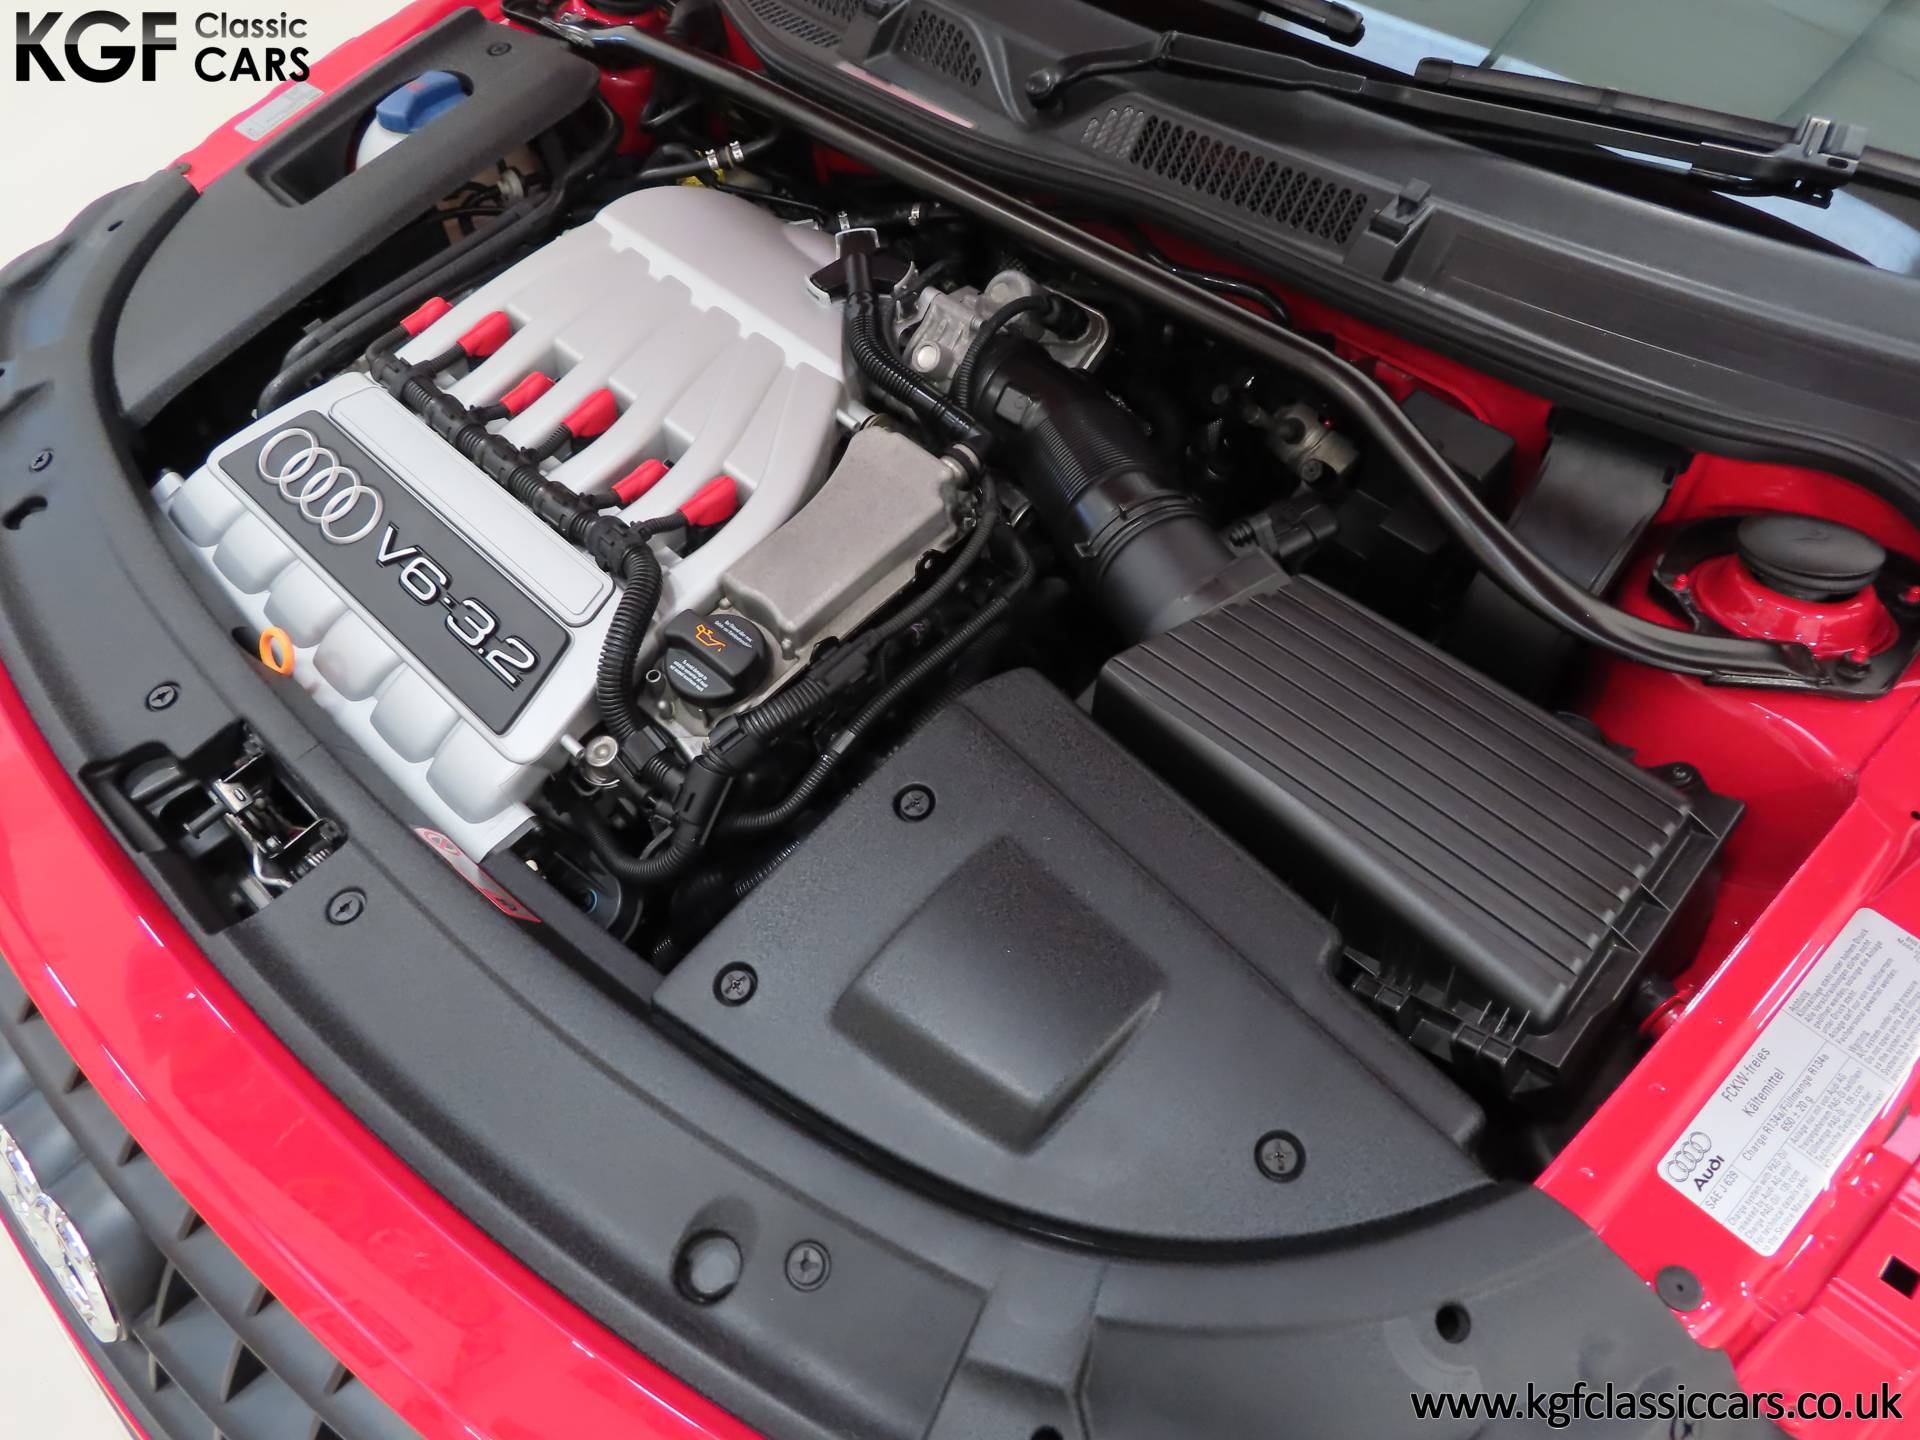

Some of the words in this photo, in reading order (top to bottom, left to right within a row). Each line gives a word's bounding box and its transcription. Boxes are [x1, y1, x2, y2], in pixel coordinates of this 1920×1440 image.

[1722, 1050, 1770, 1102] FCKW-freies
[1742, 1068, 1785, 1117] Kältemittel
[1742, 1133, 1769, 1162] Charge
[1807, 1052, 1830, 1076] R134a
[1780, 1117, 1795, 1131] 650
[1796, 1101, 1808, 1111] 20
[1694, 1155, 1724, 1191] Audi
[1705, 1192, 1723, 1209] SAE
[1725, 1171, 1739, 1186] 639
